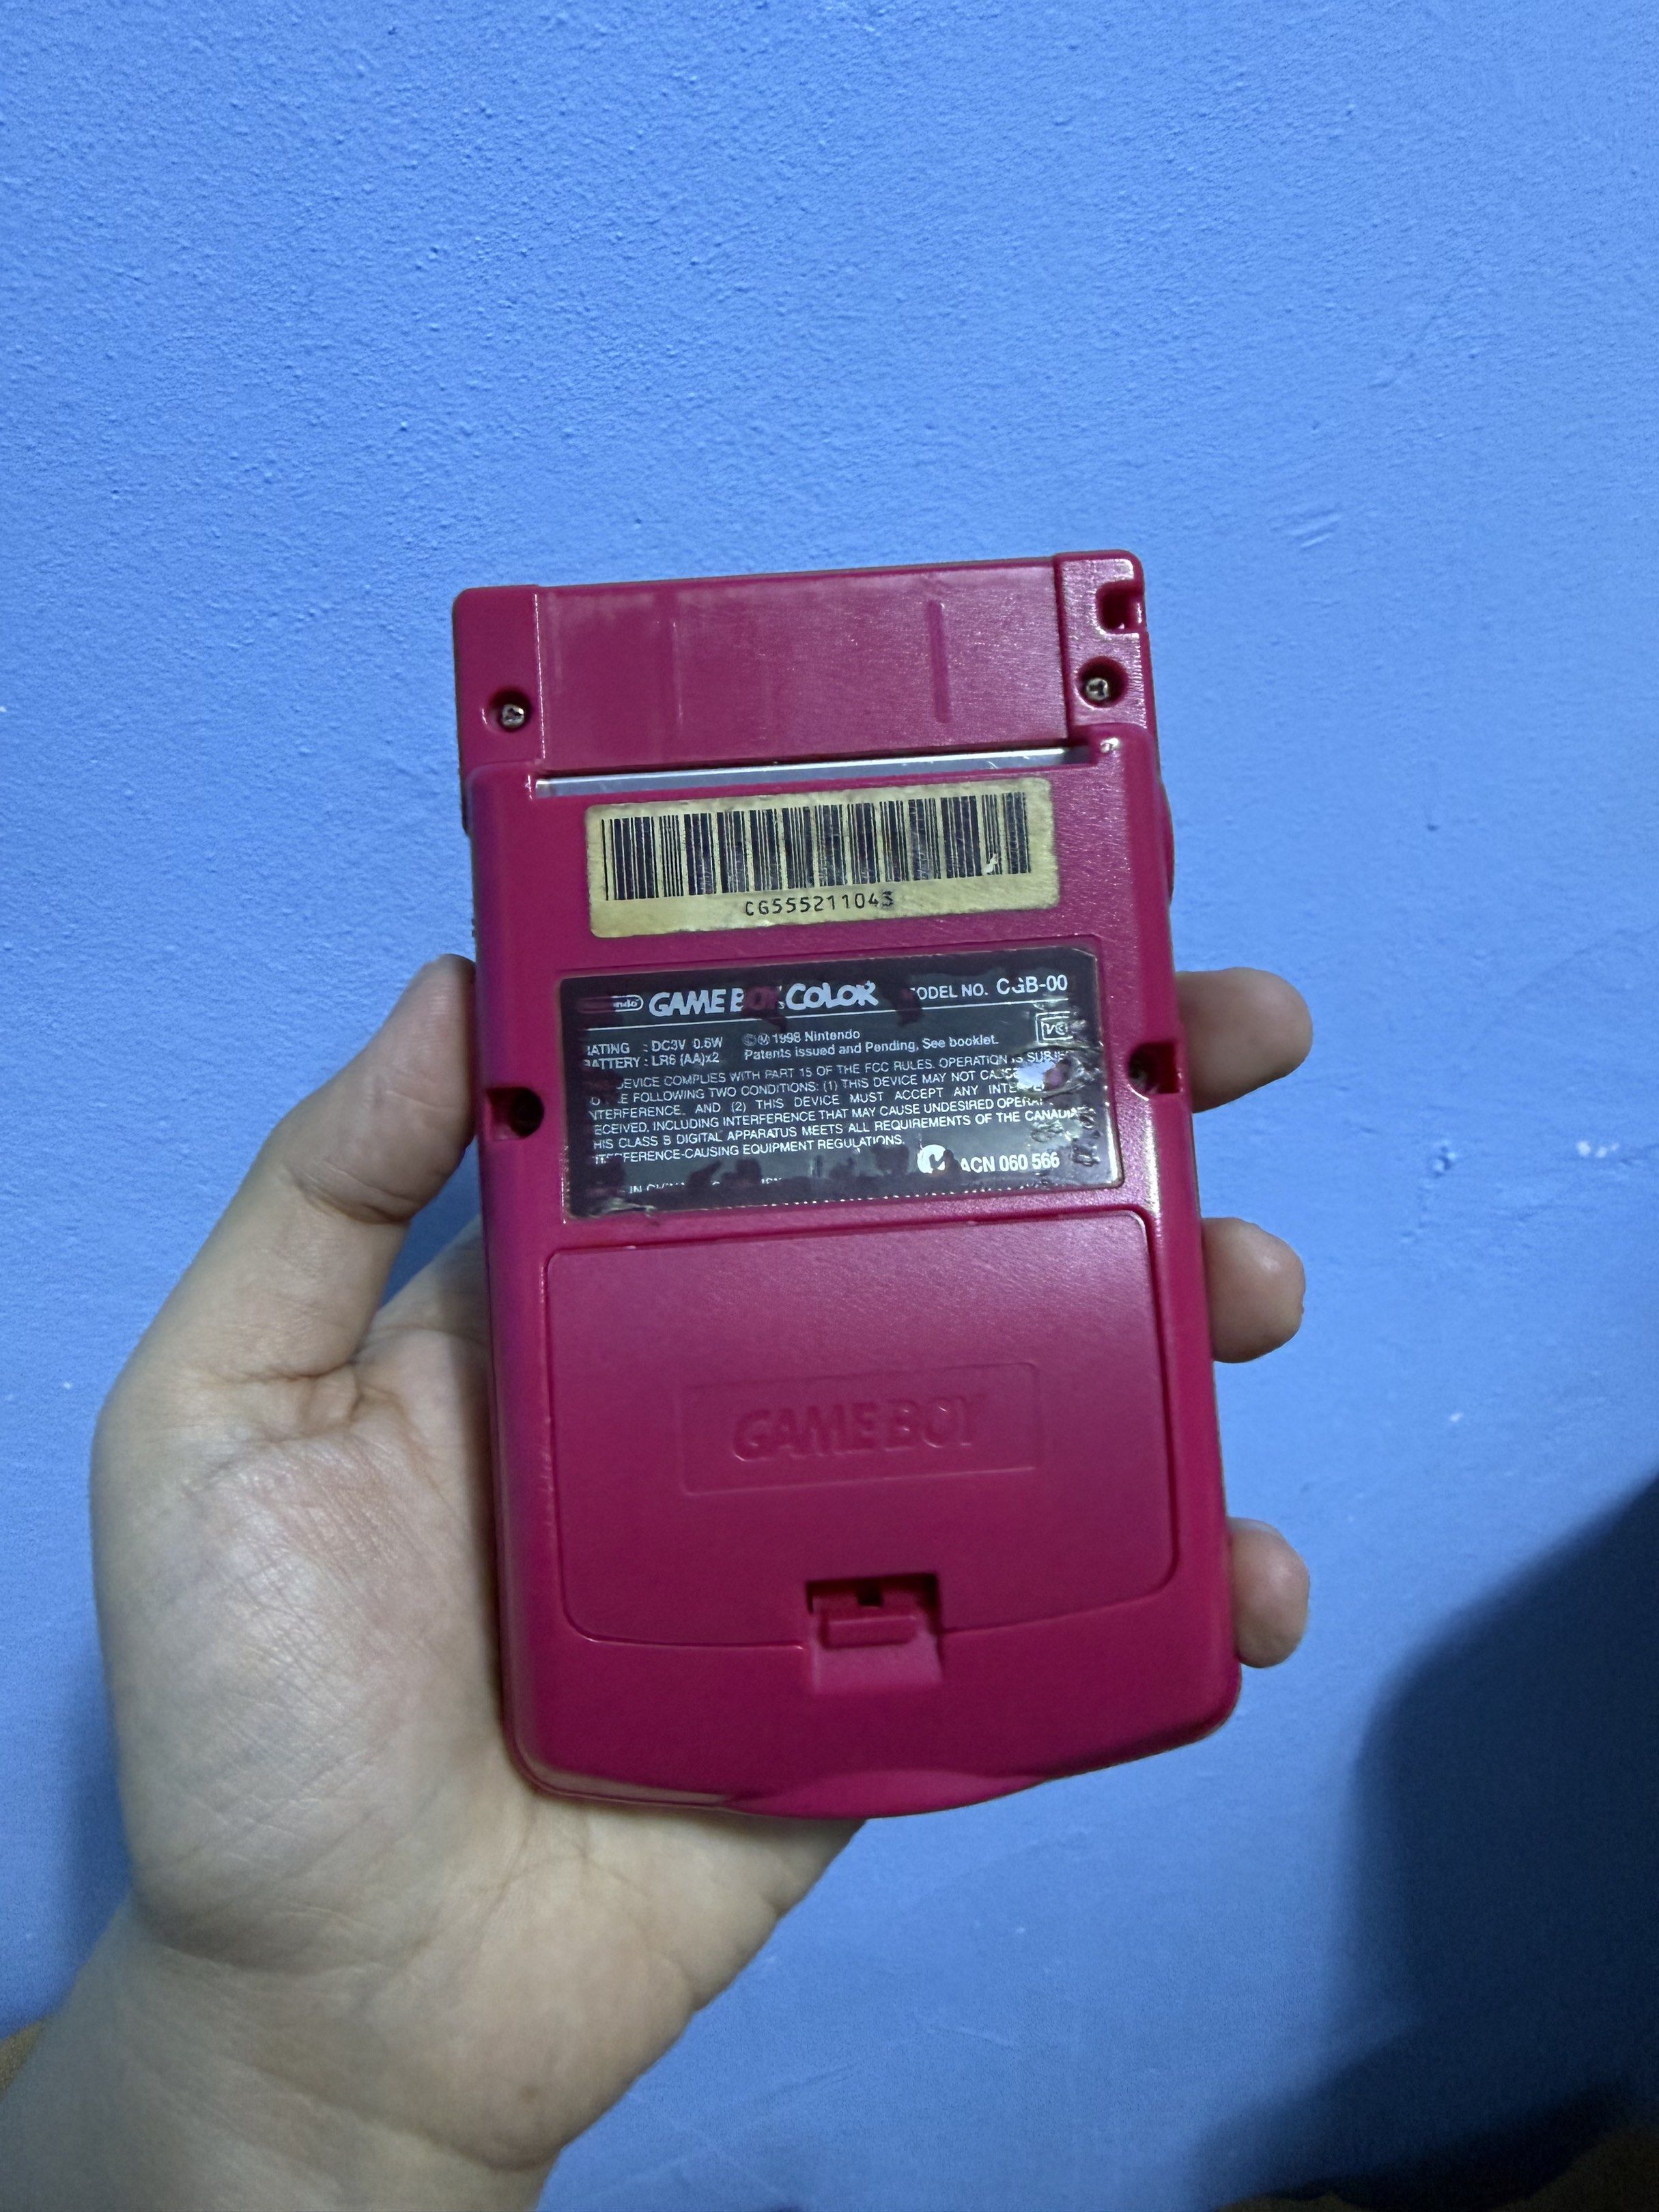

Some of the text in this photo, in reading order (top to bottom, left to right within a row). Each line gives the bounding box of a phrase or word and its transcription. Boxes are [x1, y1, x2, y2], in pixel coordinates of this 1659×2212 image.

[649, 989, 726, 1017] GAME
[785, 981, 879, 1009] COLOR
[910, 984, 958, 1000] ODEL
[961, 982, 989, 997] NO.
[651, 1038, 685, 1052] DC3V
[744, 1032, 998, 1061] Patents issued and Pending, See booklet.
[804, 1027, 860, 1042] Nintendo
[651, 1054, 676, 1066] LR6
[664, 1072, 726, 1086] COMPLIES
[730, 1070, 760, 1081] WITH
[765, 1067, 794, 1079] PART
[799, 1066, 812, 1077] 15
[817, 1065, 834, 1076] OF
[837, 1063, 860, 1075] THE
[865, 1061, 889, 1073] FCC
[893, 1058, 935, 1071] RULES.
[939, 1053, 1007, 1068] OPERATION
[634, 1088, 705, 1103] FOLLOWING
[708, 1086, 736, 1098] TWO
[741, 1081, 819, 1096] CONDITIONS:
[823, 1079, 837, 1090] (1)
[841, 1077, 868, 1090] THIS
[874, 1075, 917, 1088] DEVICE
[922, 1073, 946, 1084] MAY
[952, 1070, 975, 1082] NOT
[695, 1102, 720, 1114] AND
[732, 1101, 746, 1111] (2)
[755, 1098, 784, 1110] THIS
[795, 1094, 840, 1107] DEVICE
[849, 1092, 883, 1104] MUST
[894, 1088, 944, 1101] ACCEPT
[954, 1085, 978, 1097] ANY
[653, 1117, 718, 1131] INCLUDING
[723, 1111, 816, 1126] INTERFERENCE
[818, 1108, 849, 1120] THAT
[852, 1107, 875, 1118] MAY
[880, 1104, 920, 1116] CAUSE
[924, 1098, 994, 1114] UNDESIRED
[593, 1138, 613, 1150] HIS
[619, 1135, 658, 1148] CLASS
[664, 1135, 671, 1145] B
[677, 1131, 722, 1144] DIGITAL
[727, 1126, 797, 1141] APPARATUS
[802, 1123, 842, 1136] MEETS
[849, 1122, 870, 1133] ALL
[875, 1115, 971, 1131] REQUIREMENTS
[975, 1114, 992, 1124] OF
[996, 1111, 1020, 1123] THE
[743, 1140, 814, 1155] EQUIPMENT
[818, 1134, 905, 1150] REGULATIONS.
[961, 1152, 1060, 1173] ACN 060 566
[733, 1402, 881, 1461] GAME
